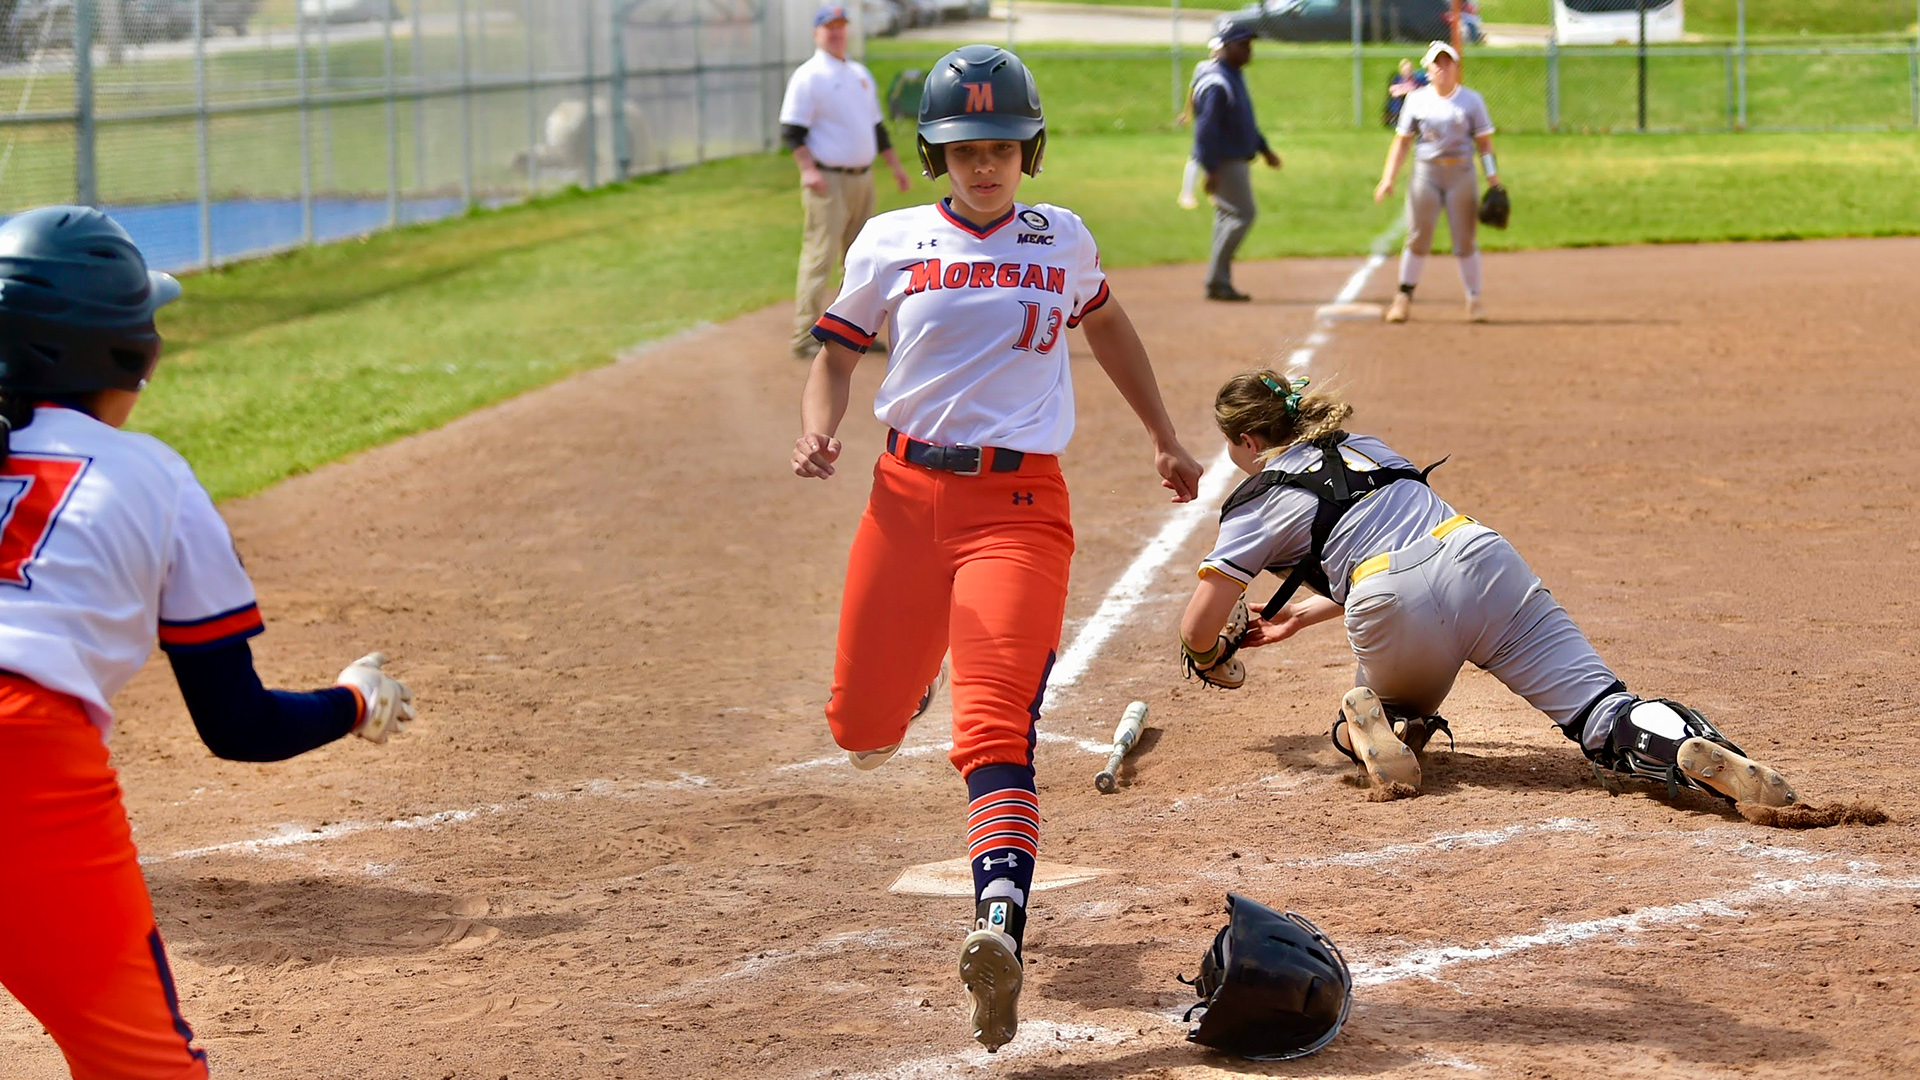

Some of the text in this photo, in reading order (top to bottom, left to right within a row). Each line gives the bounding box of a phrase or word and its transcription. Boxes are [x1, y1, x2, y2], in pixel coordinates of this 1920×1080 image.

[1017, 233, 1054, 245] MEAC
[898, 258, 1066, 295] MORGAN
[1012, 300, 1063, 355] 13
